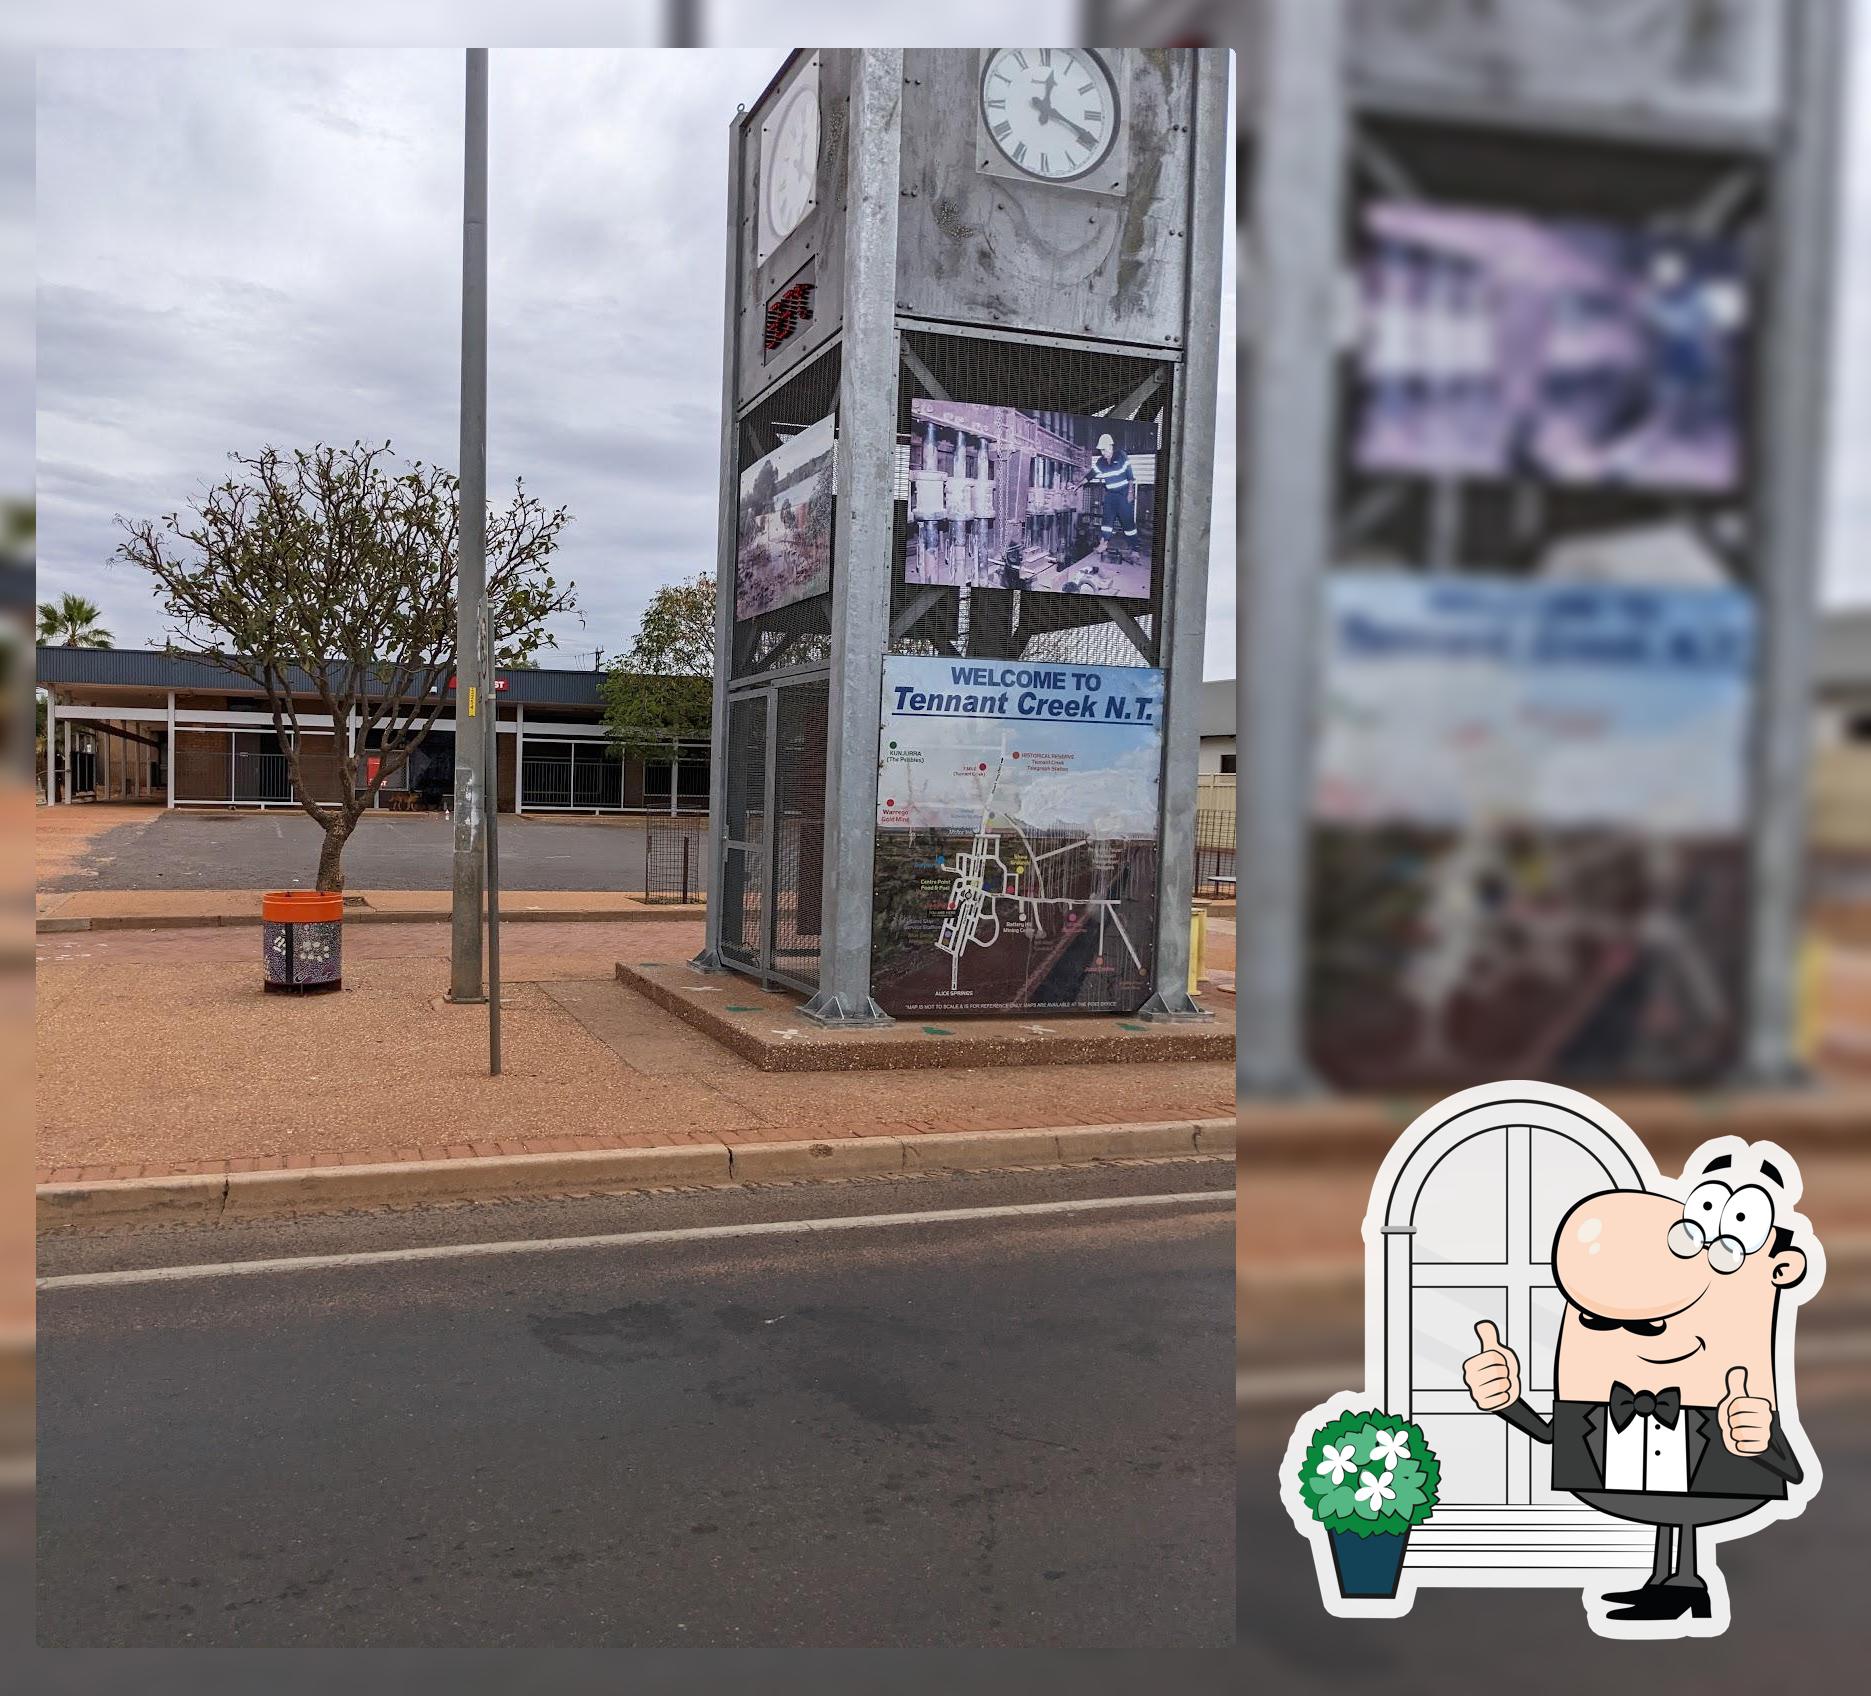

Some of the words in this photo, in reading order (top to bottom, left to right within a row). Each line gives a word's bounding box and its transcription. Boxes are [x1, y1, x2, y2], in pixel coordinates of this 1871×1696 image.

[950, 666, 1066, 690] WELCOME
[1071, 672, 1102, 692] TO
[894, 686, 1009, 714] Tennant
[1017, 691, 1098, 718] Creek
[1105, 695, 1154, 720] N.T.
